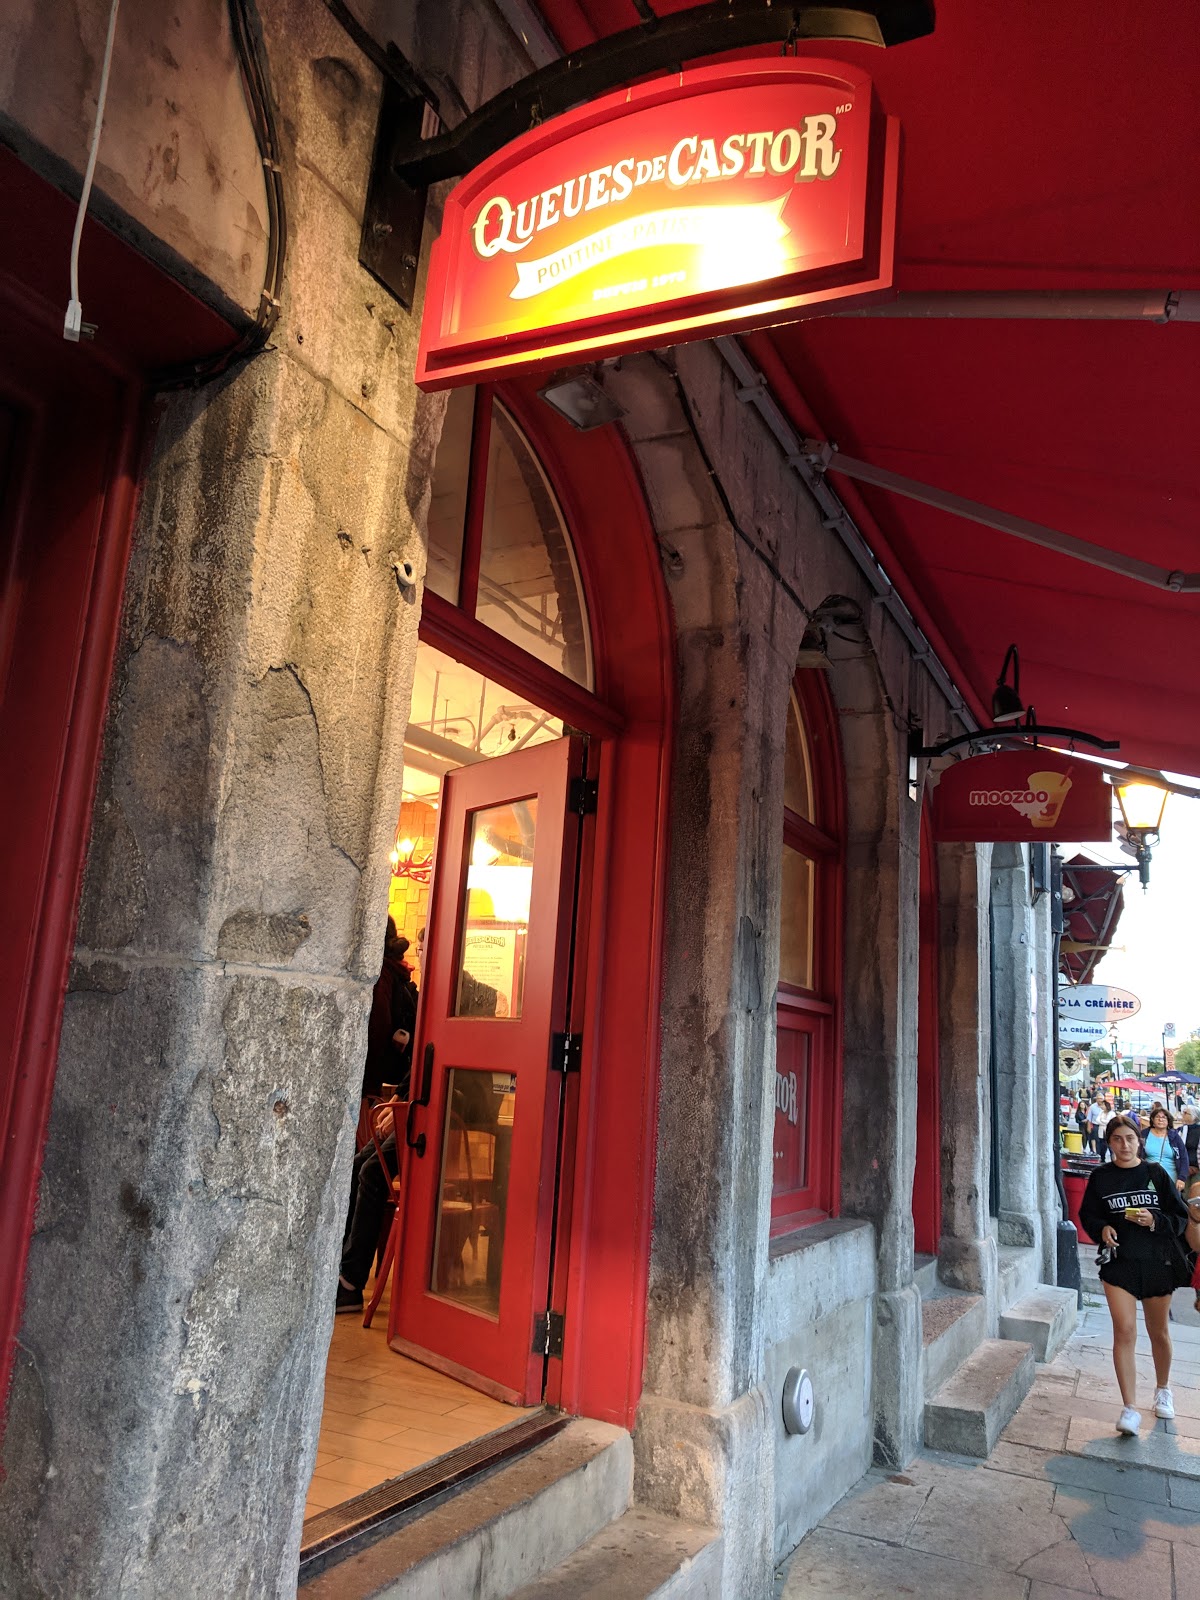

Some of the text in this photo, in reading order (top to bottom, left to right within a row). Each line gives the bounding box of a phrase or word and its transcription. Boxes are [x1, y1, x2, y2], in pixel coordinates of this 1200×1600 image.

[835, 103, 853, 114] MD
[472, 113, 843, 258] QUEUES DE CASTOR
[536, 233, 618, 284] POUTINE
[970, 790, 1049, 806] moozoo
[1068, 997, 1134, 1009] LA CRÉMIÈRE
[775, 1071, 799, 1125] TOR
[1107, 1194, 1160, 1210] MOL BUS 2
